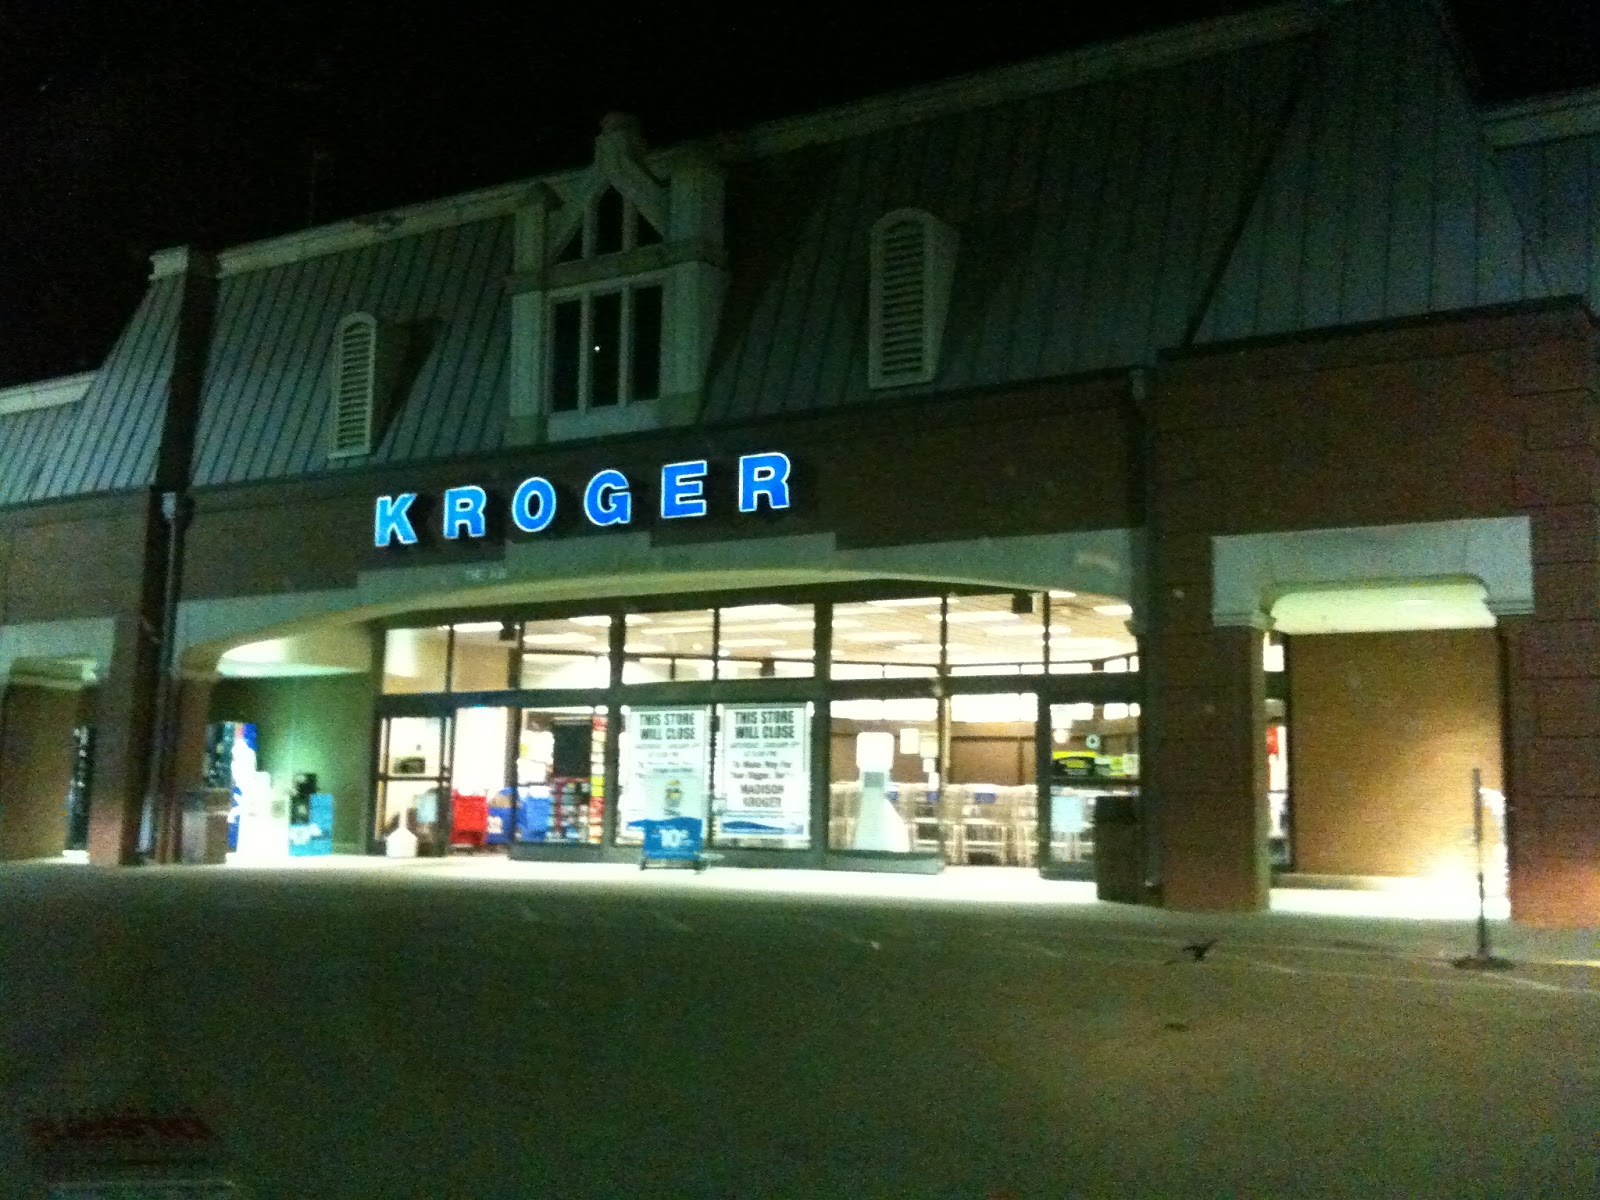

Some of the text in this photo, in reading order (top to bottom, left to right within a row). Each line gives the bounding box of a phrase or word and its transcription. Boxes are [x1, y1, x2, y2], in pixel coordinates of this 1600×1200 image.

[374, 452, 791, 547] KROGER
[640, 713, 694, 725] THIS STORE
[735, 711, 794, 724] THIS STORE
[640, 727, 695, 740] WILL CLOSE
[735, 726, 794, 739] WILL CLOSE
